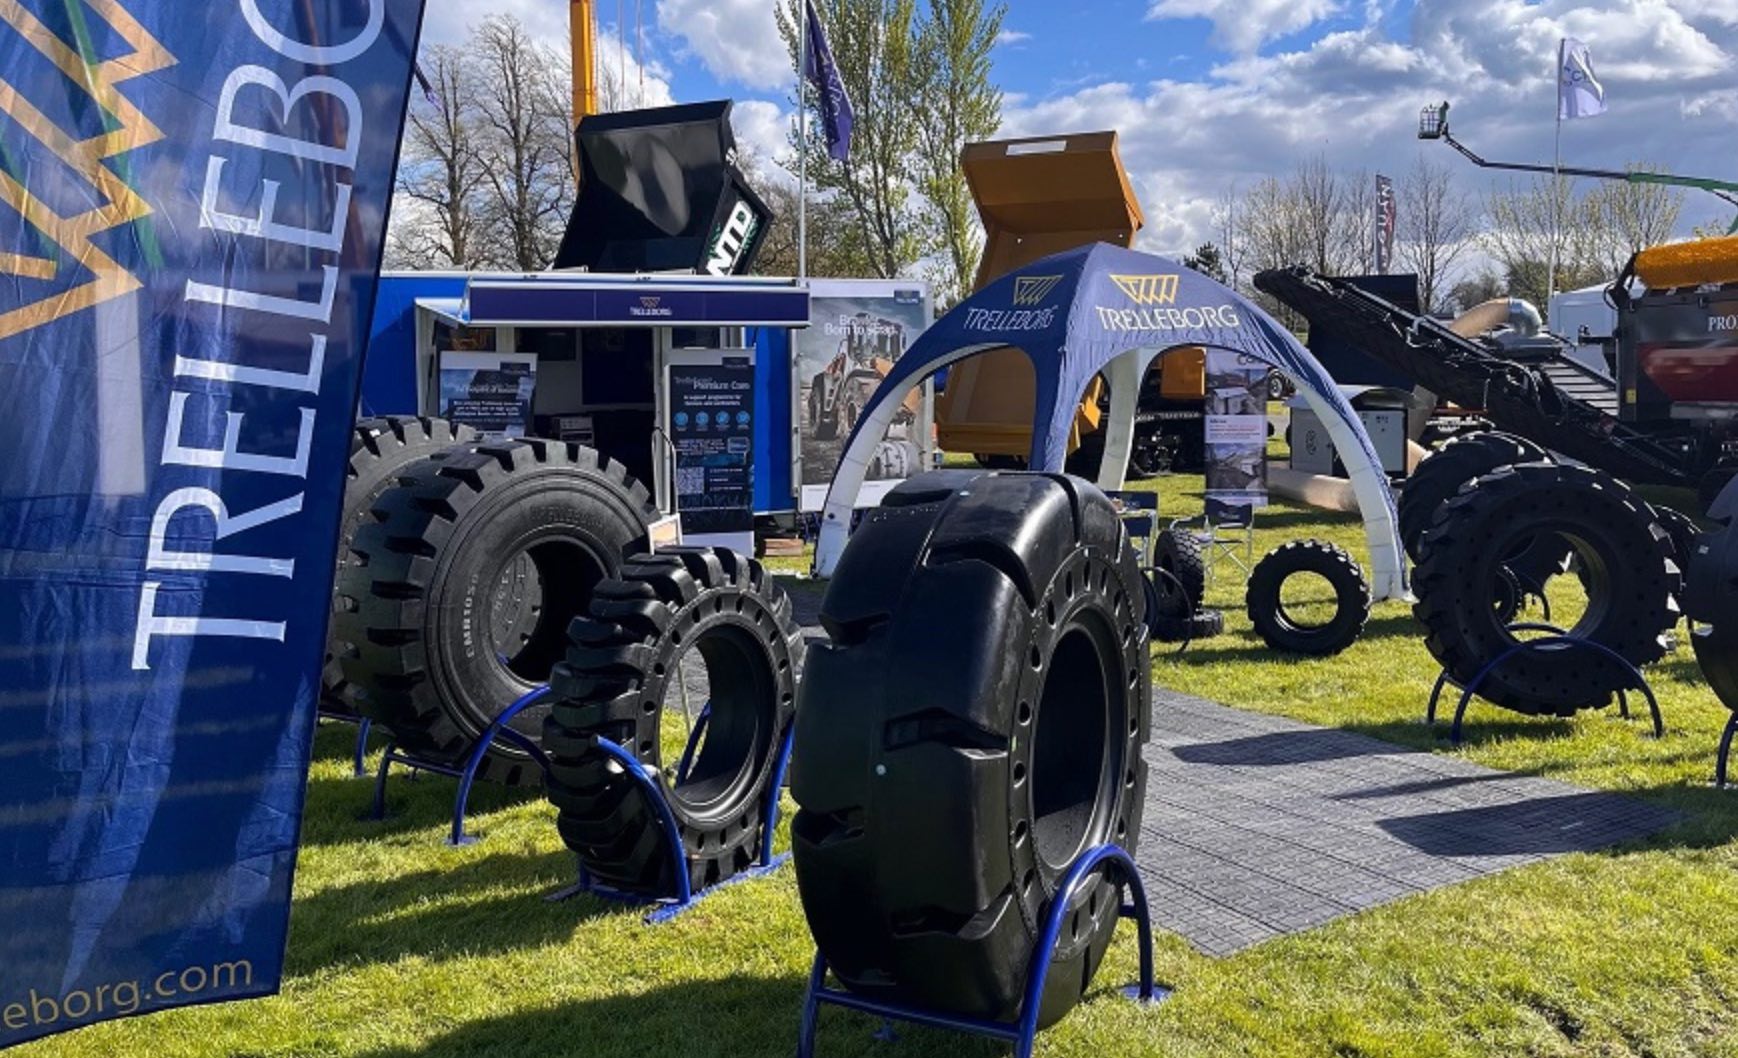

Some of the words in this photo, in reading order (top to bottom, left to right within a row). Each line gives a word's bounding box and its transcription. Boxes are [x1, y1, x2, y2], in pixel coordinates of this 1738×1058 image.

[963, 305, 1058, 332] TRELLEBORG
[1095, 304, 1240, 331] TRELLEBORG
[1708, 314, 1738, 332] PRO
